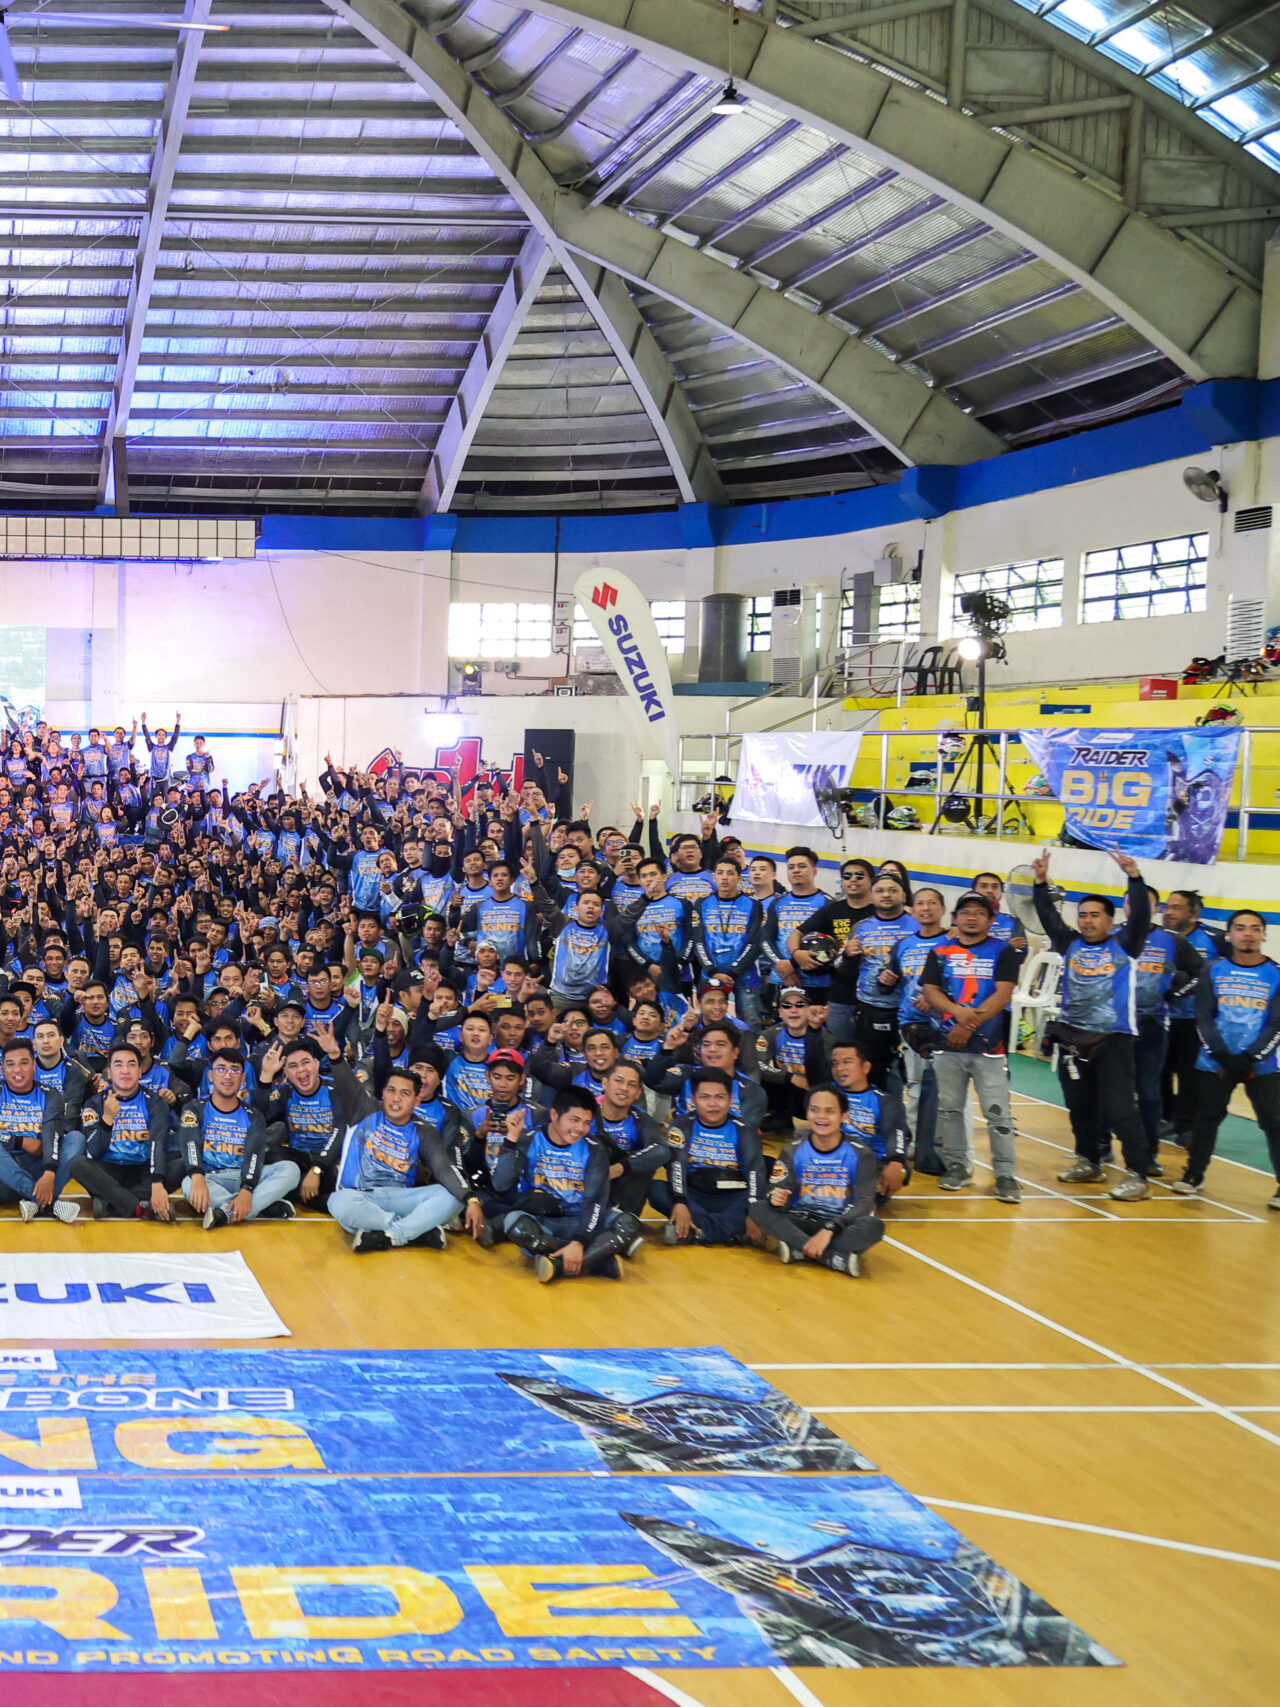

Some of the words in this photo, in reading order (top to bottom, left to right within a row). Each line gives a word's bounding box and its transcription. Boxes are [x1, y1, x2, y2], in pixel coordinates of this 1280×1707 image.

[608, 614, 665, 723] SUZUKI
[1068, 747, 1150, 766] RAIDER
[48, 1372, 157, 1386] THE
[76, 1647, 363, 1665] PROMOTING
[378, 1647, 515, 1663] ROAD
[529, 1646, 723, 1662] SAFETY
